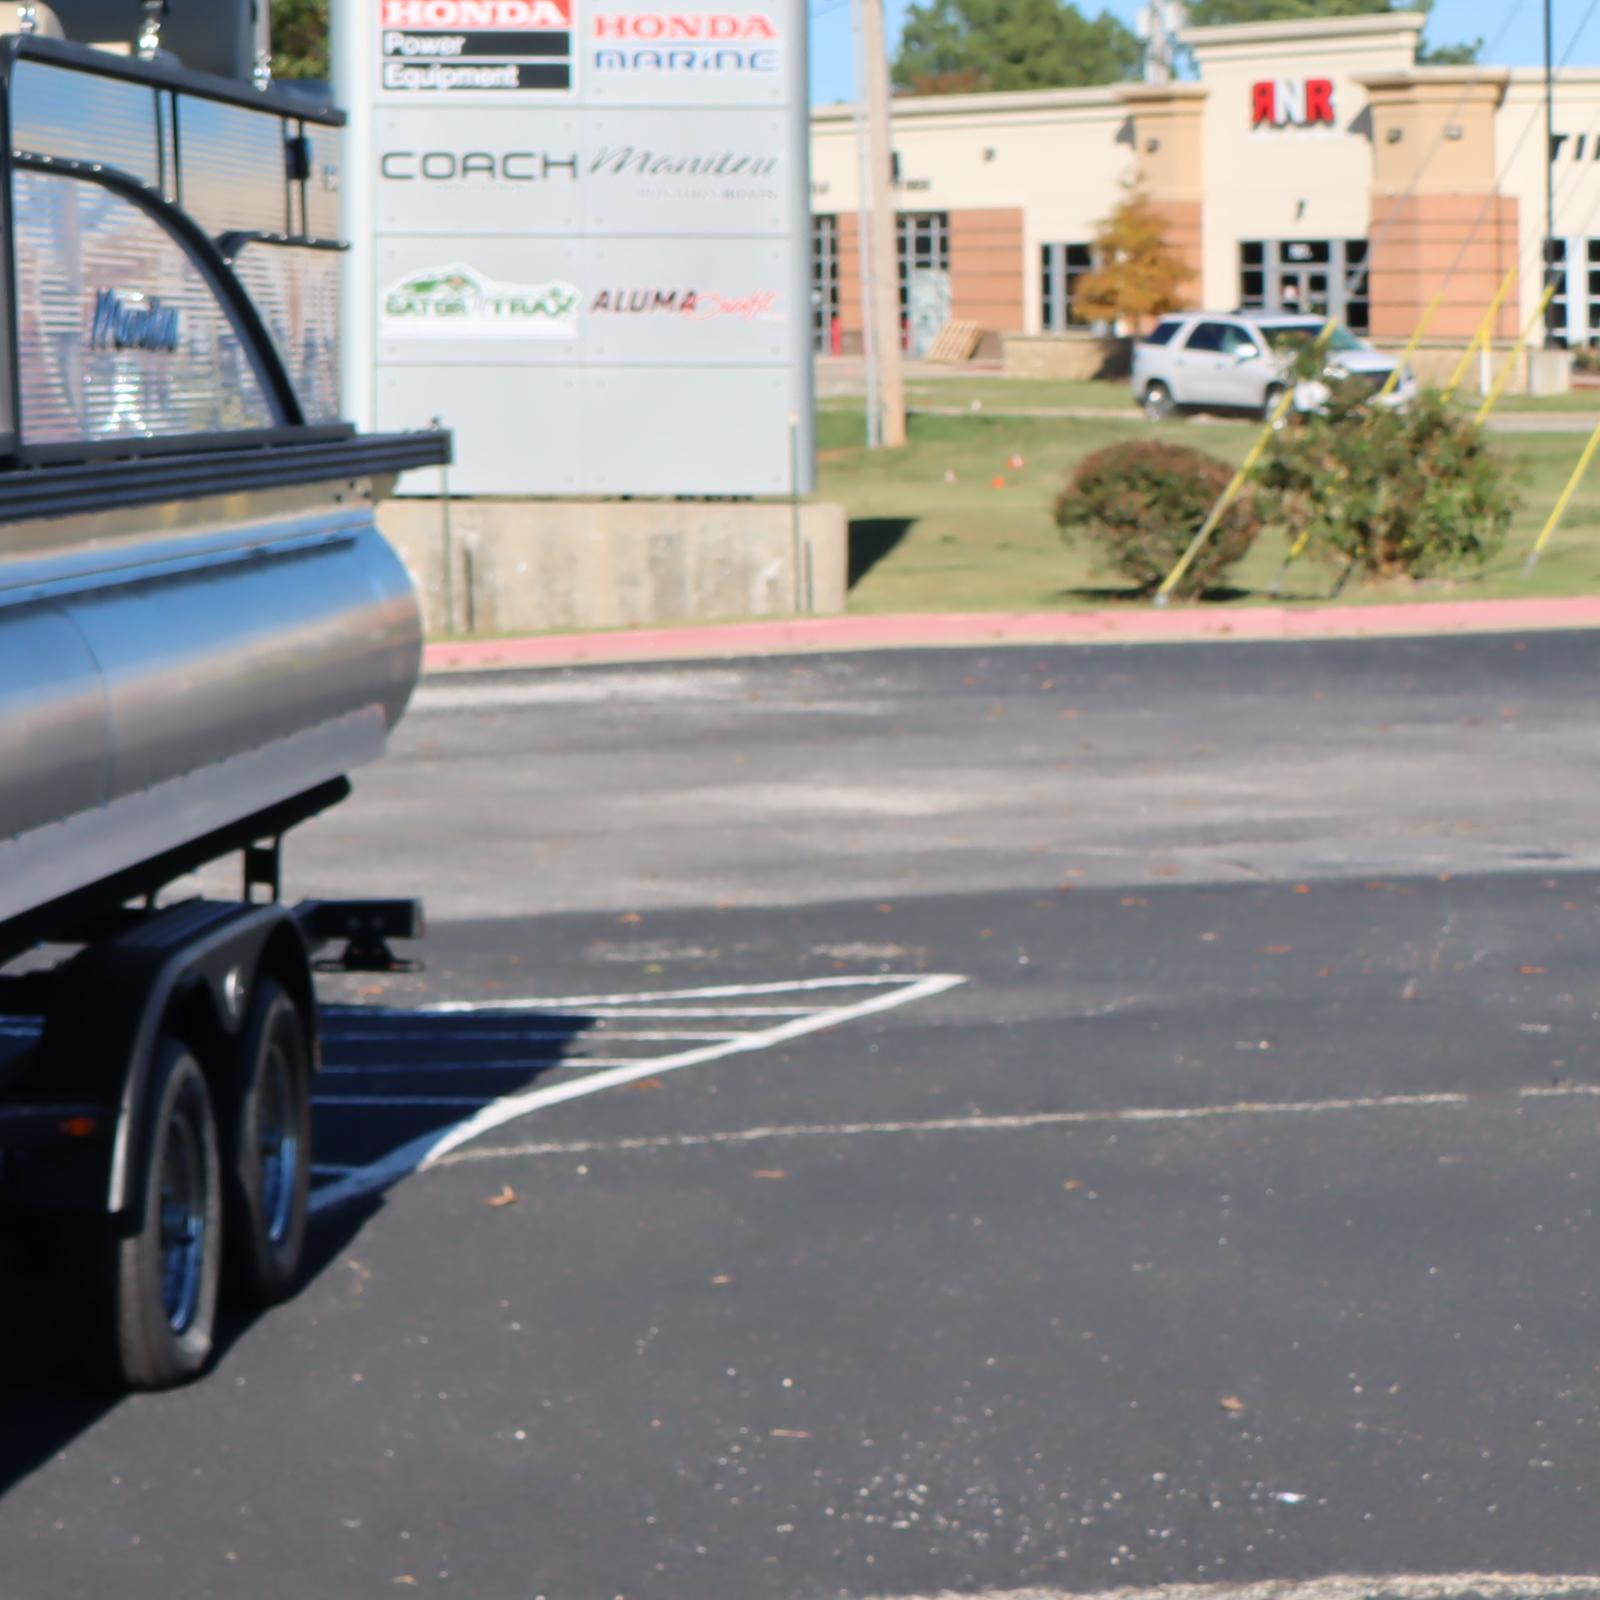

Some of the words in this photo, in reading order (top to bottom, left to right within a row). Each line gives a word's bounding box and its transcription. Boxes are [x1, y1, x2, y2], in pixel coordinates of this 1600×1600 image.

[384, 0, 567, 26] HONDA
[593, 15, 778, 39] HONDA
[384, 32, 467, 56] Power
[384, 63, 520, 90] Equipment
[1547, 132, 1600, 162] TI
[381, 151, 579, 180] COACH
